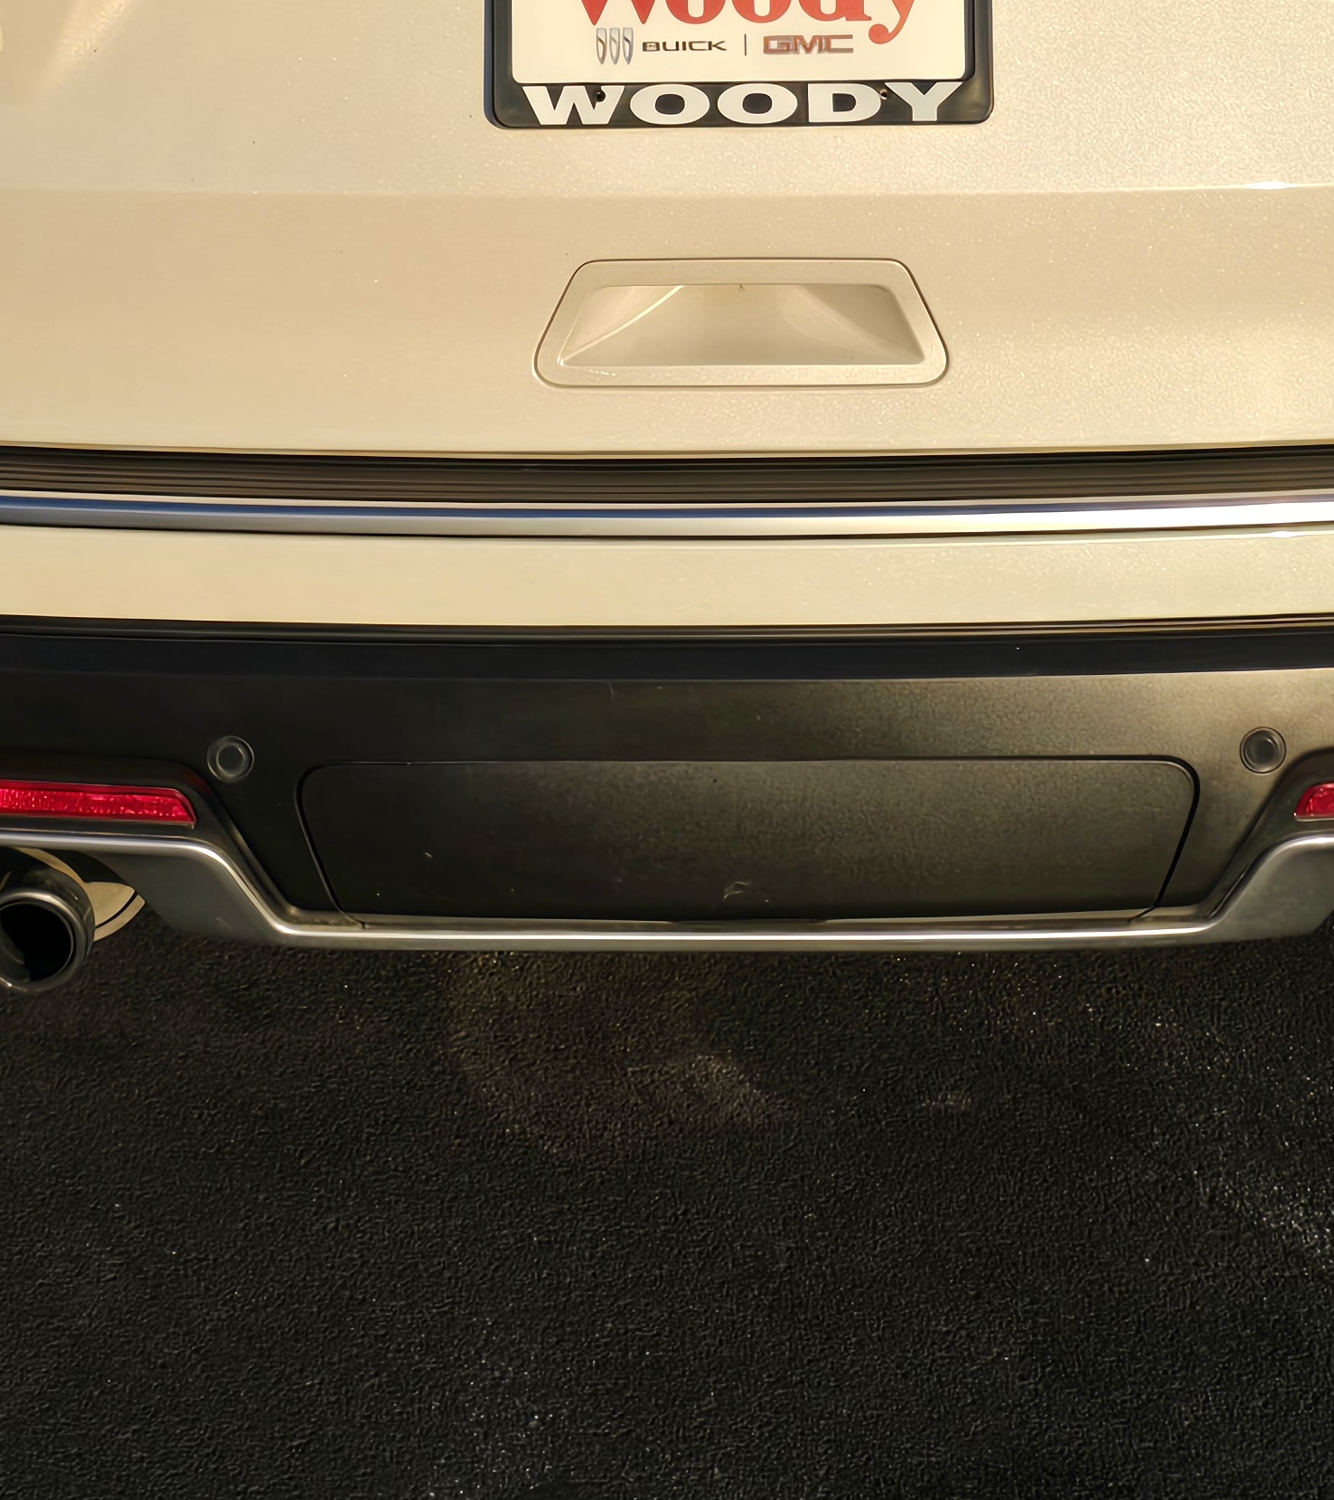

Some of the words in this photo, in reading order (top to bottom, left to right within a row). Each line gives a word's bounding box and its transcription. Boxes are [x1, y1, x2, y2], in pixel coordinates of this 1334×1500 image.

[642, 40, 728, 52] BUICK
[763, 34, 854, 55] GMC
[522, 81, 964, 125] WOODY
